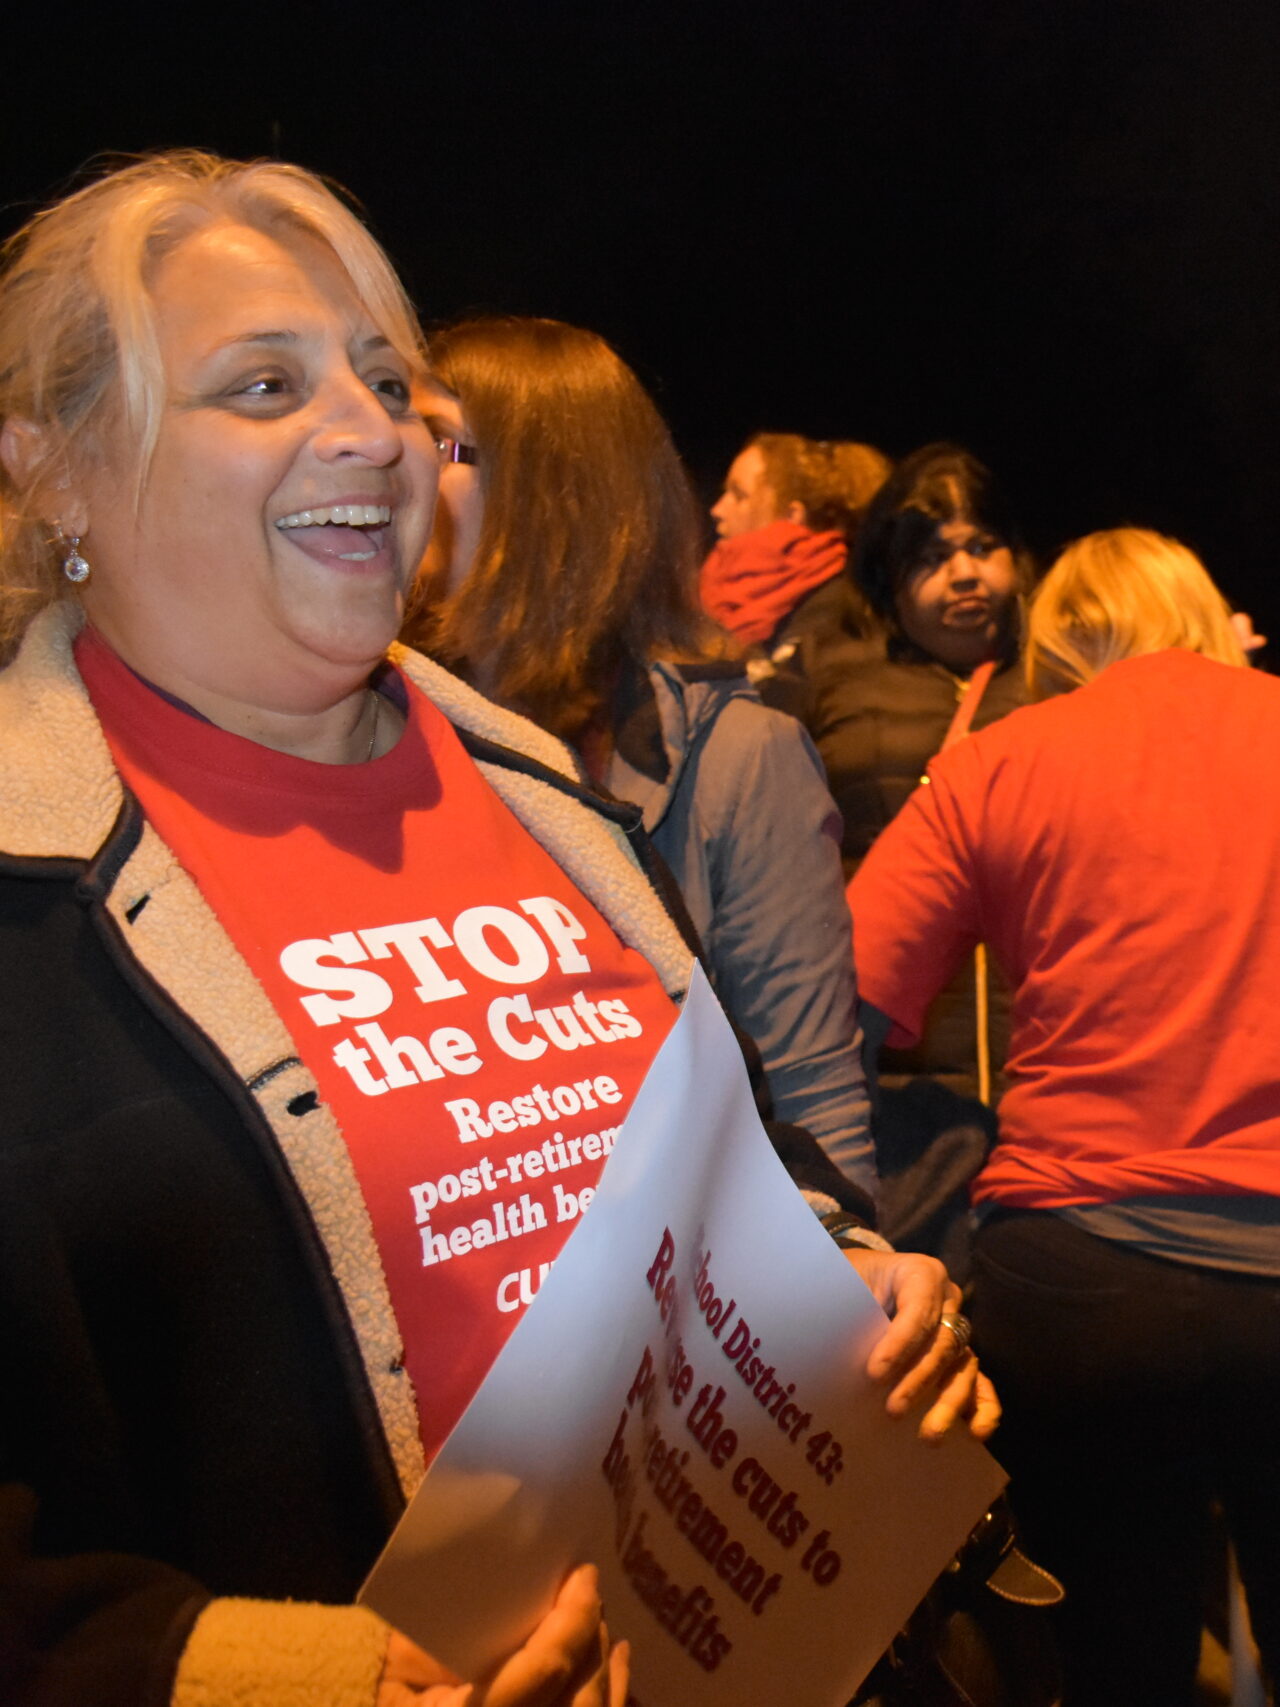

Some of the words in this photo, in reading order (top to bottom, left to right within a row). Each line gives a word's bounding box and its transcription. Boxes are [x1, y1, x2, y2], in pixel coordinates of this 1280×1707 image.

[280, 896, 590, 1027] STOP
[333, 1022, 483, 1096] the
[487, 991, 642, 1060] Cuts
[445, 1075, 622, 1143] Restore
[419, 1194, 547, 1267] health
[552, 1183, 599, 1223] be
[496, 1260, 556, 1313] CU
[722, 1317, 810, 1444] District
[806, 1431, 844, 1486] 43:
[686, 1384, 738, 1470] the
[732, 1457, 810, 1549] cuts
[801, 1531, 842, 1586] to
